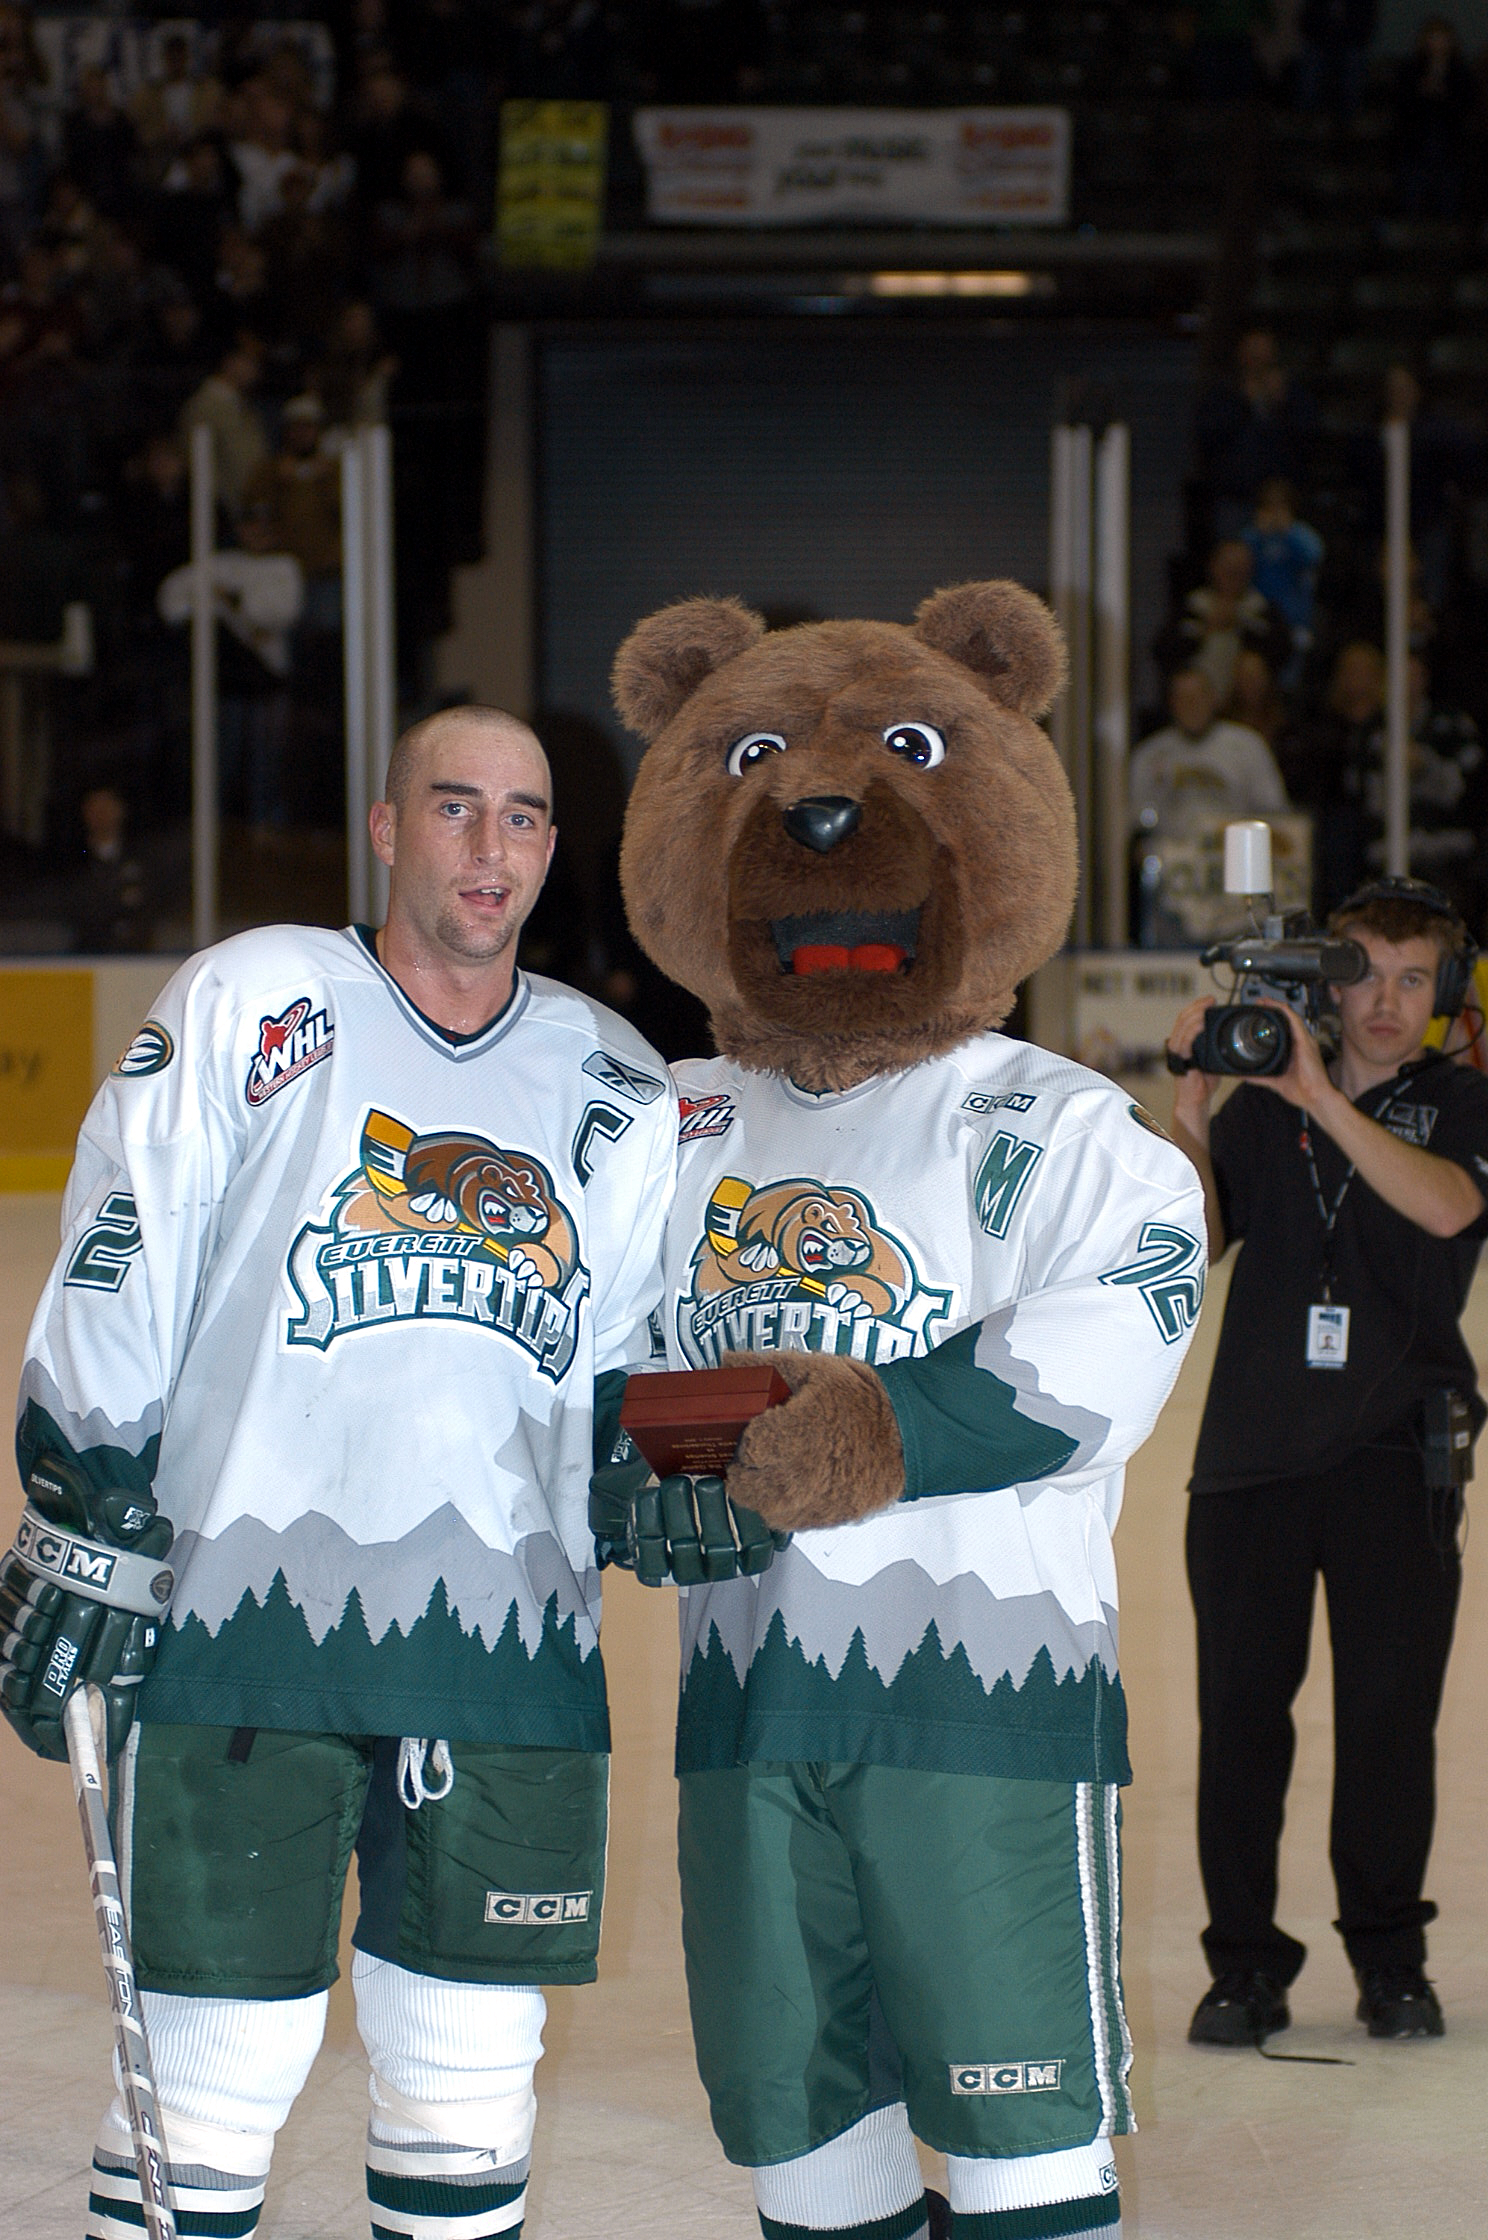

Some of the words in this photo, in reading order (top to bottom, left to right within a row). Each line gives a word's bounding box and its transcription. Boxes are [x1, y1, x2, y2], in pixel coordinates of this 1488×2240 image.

[252, 1009, 334, 1086] WHL
[974, 1130, 1043, 1240] M
[318, 1232, 483, 1266] EVERETT
[287, 1223, 591, 1382] SILVERTIPS
[691, 1276, 801, 1335] EVERETT
[15, 1520, 115, 1587] CCM
[43, 1637, 72, 1697] PRO
[487, 1894, 590, 1922] CCM
[953, 2063, 1060, 2091] CCM
